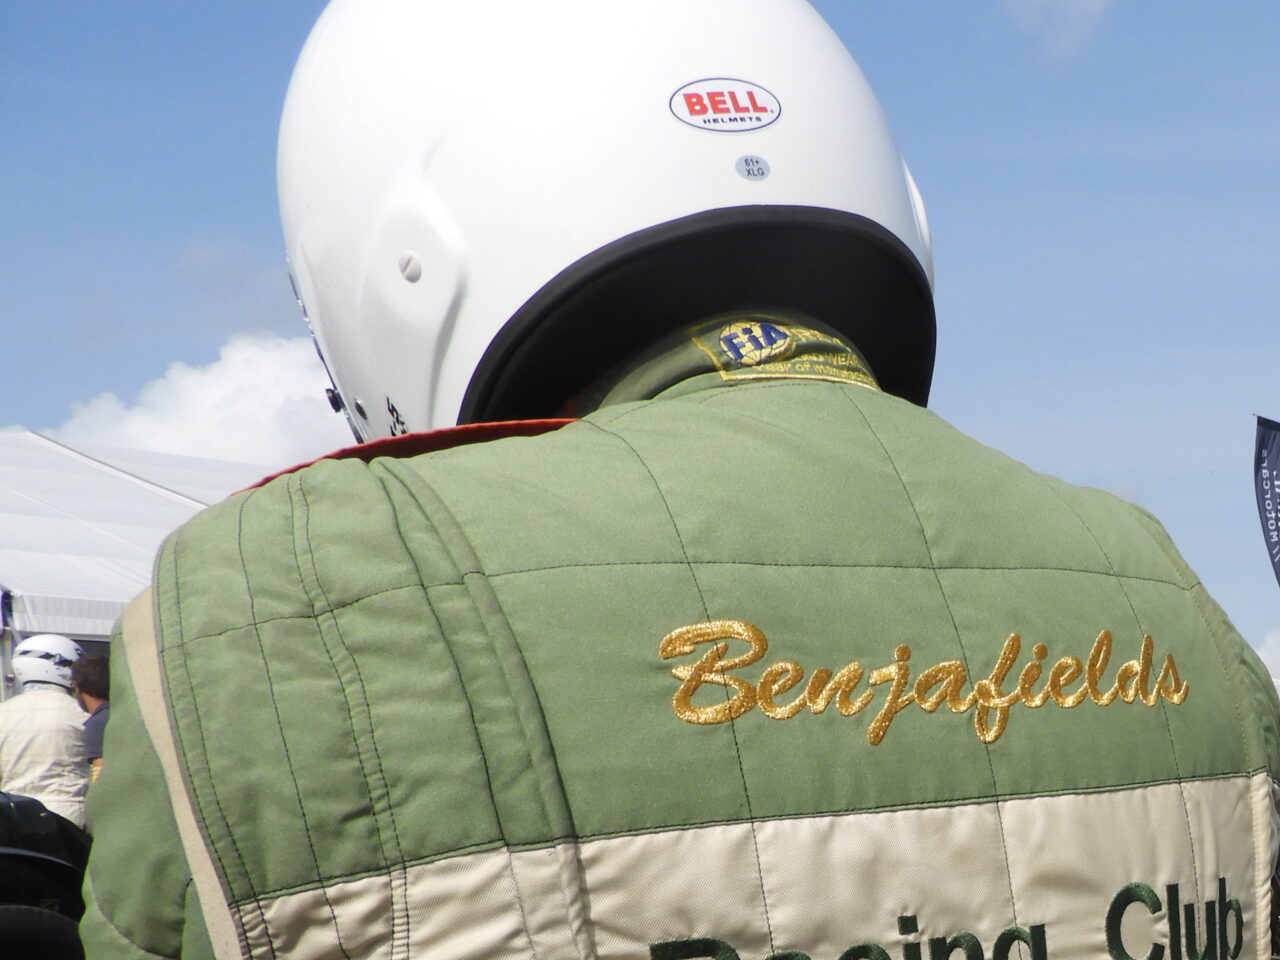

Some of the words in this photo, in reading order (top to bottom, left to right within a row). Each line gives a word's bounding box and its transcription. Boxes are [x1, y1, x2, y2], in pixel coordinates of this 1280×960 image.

[682, 91, 769, 117] BELL
[702, 116, 762, 125] HELMETS
[744, 158, 760, 167] 61+
[745, 167, 765, 177] XLG
[658, 619, 1189, 746] Benjafields
